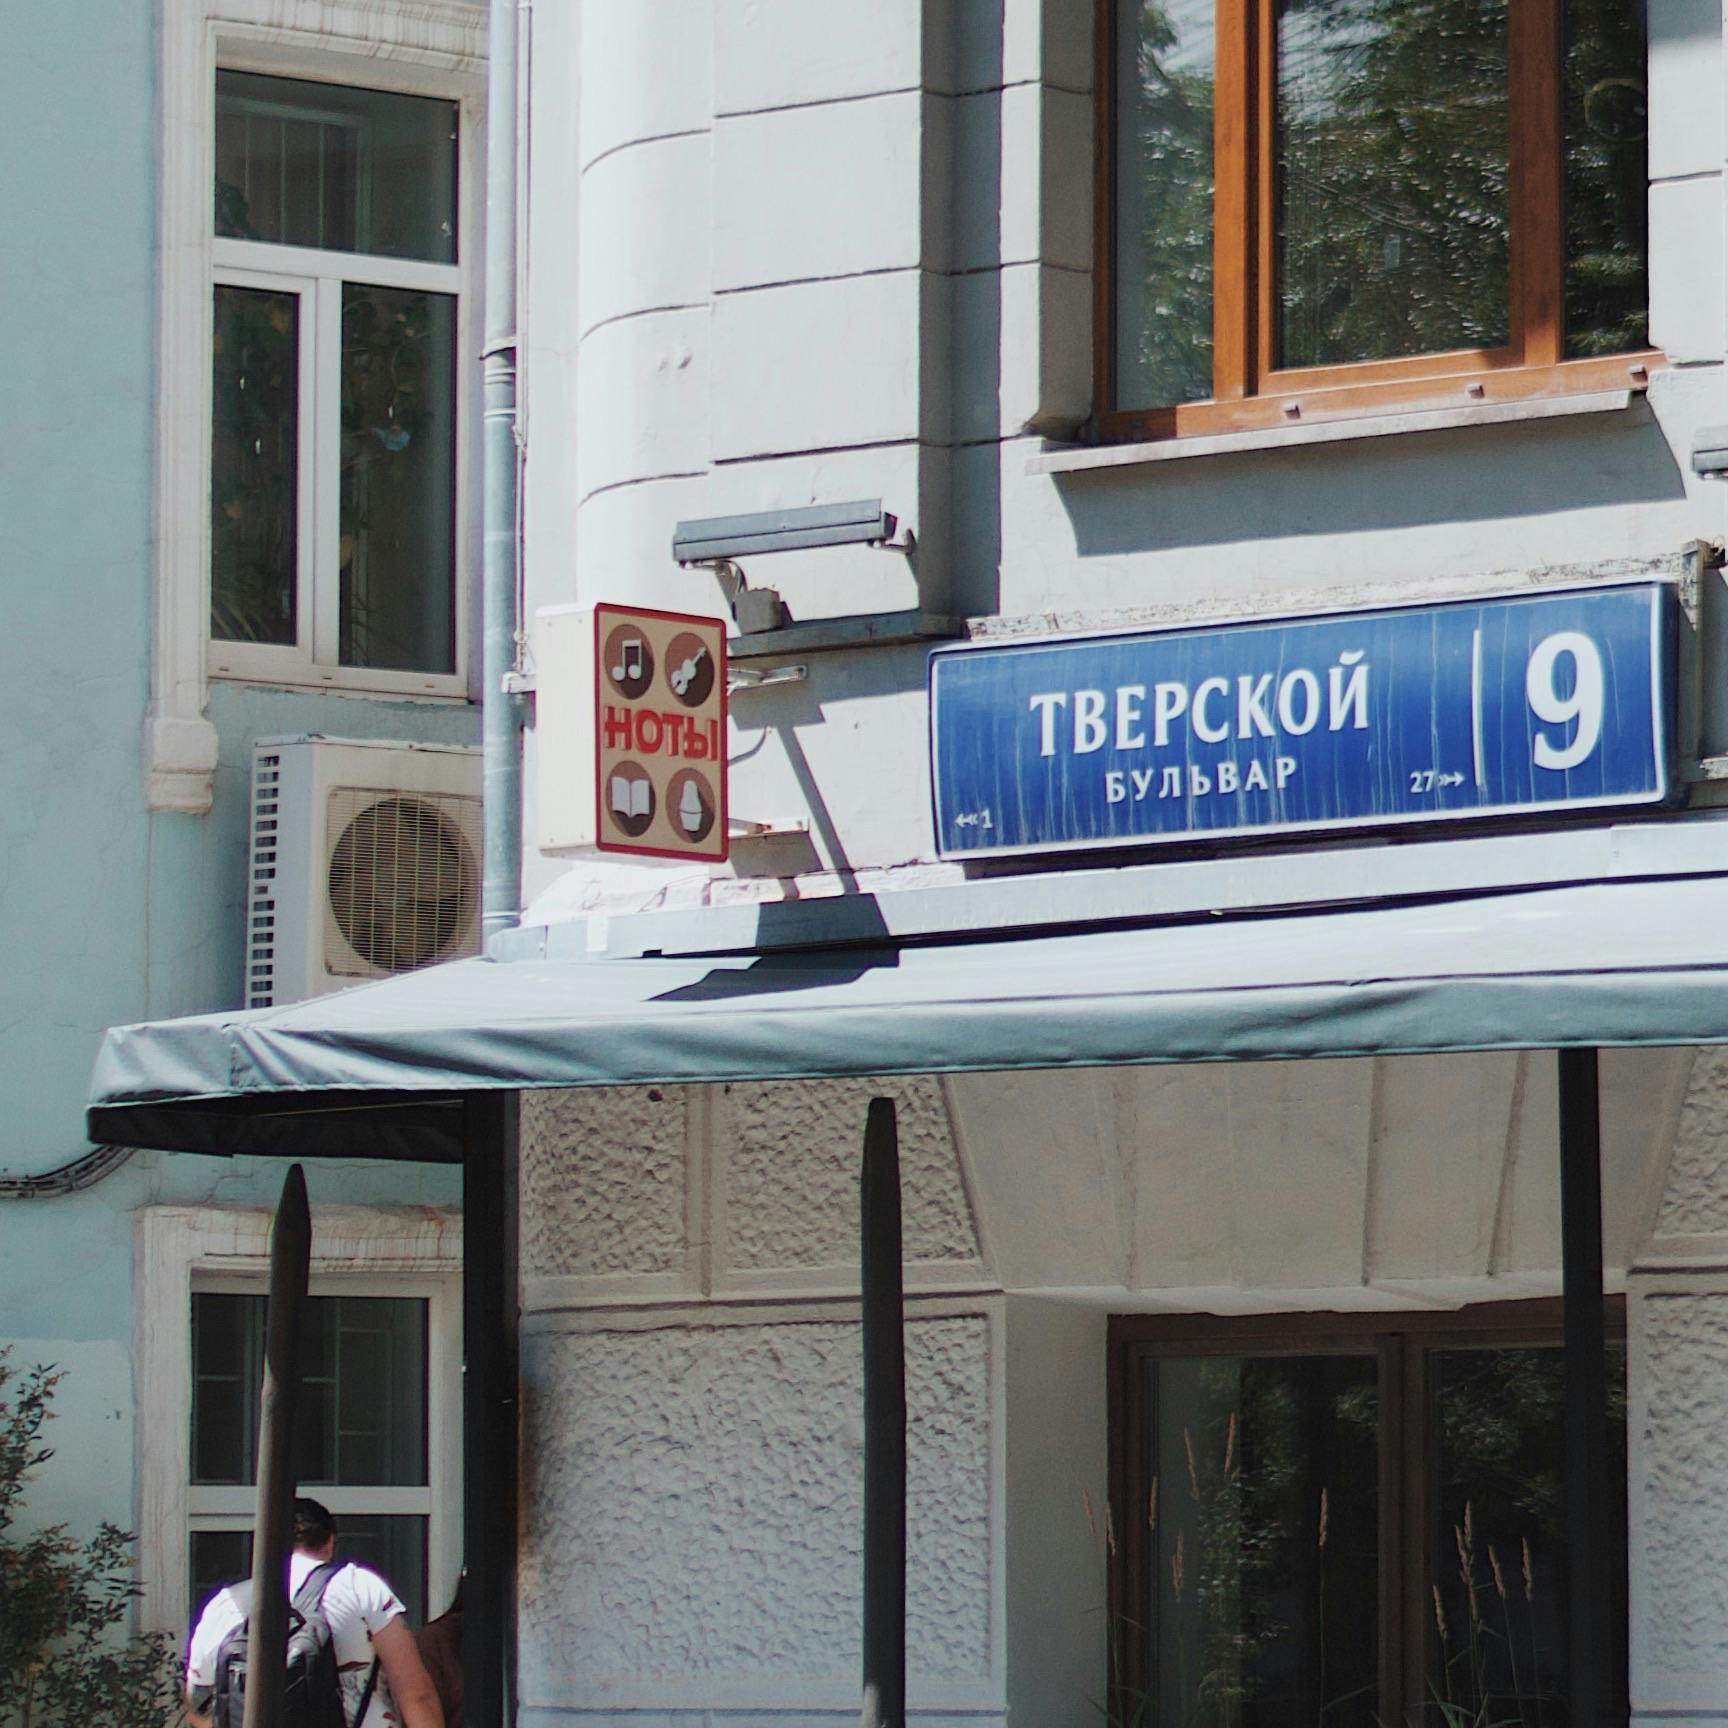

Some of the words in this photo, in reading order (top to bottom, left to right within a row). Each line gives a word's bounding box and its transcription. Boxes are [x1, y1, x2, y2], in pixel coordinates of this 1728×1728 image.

[1028, 648, 1369, 758] ТВЕРСКОЙ
[1526, 631, 1604, 770] 9
[604, 705, 718, 762] НОТЫ
[1104, 756, 1299, 803] БУЛЬВАР
[1409, 770, 1436, 792] 27
[980, 809, 993, 828] 1
